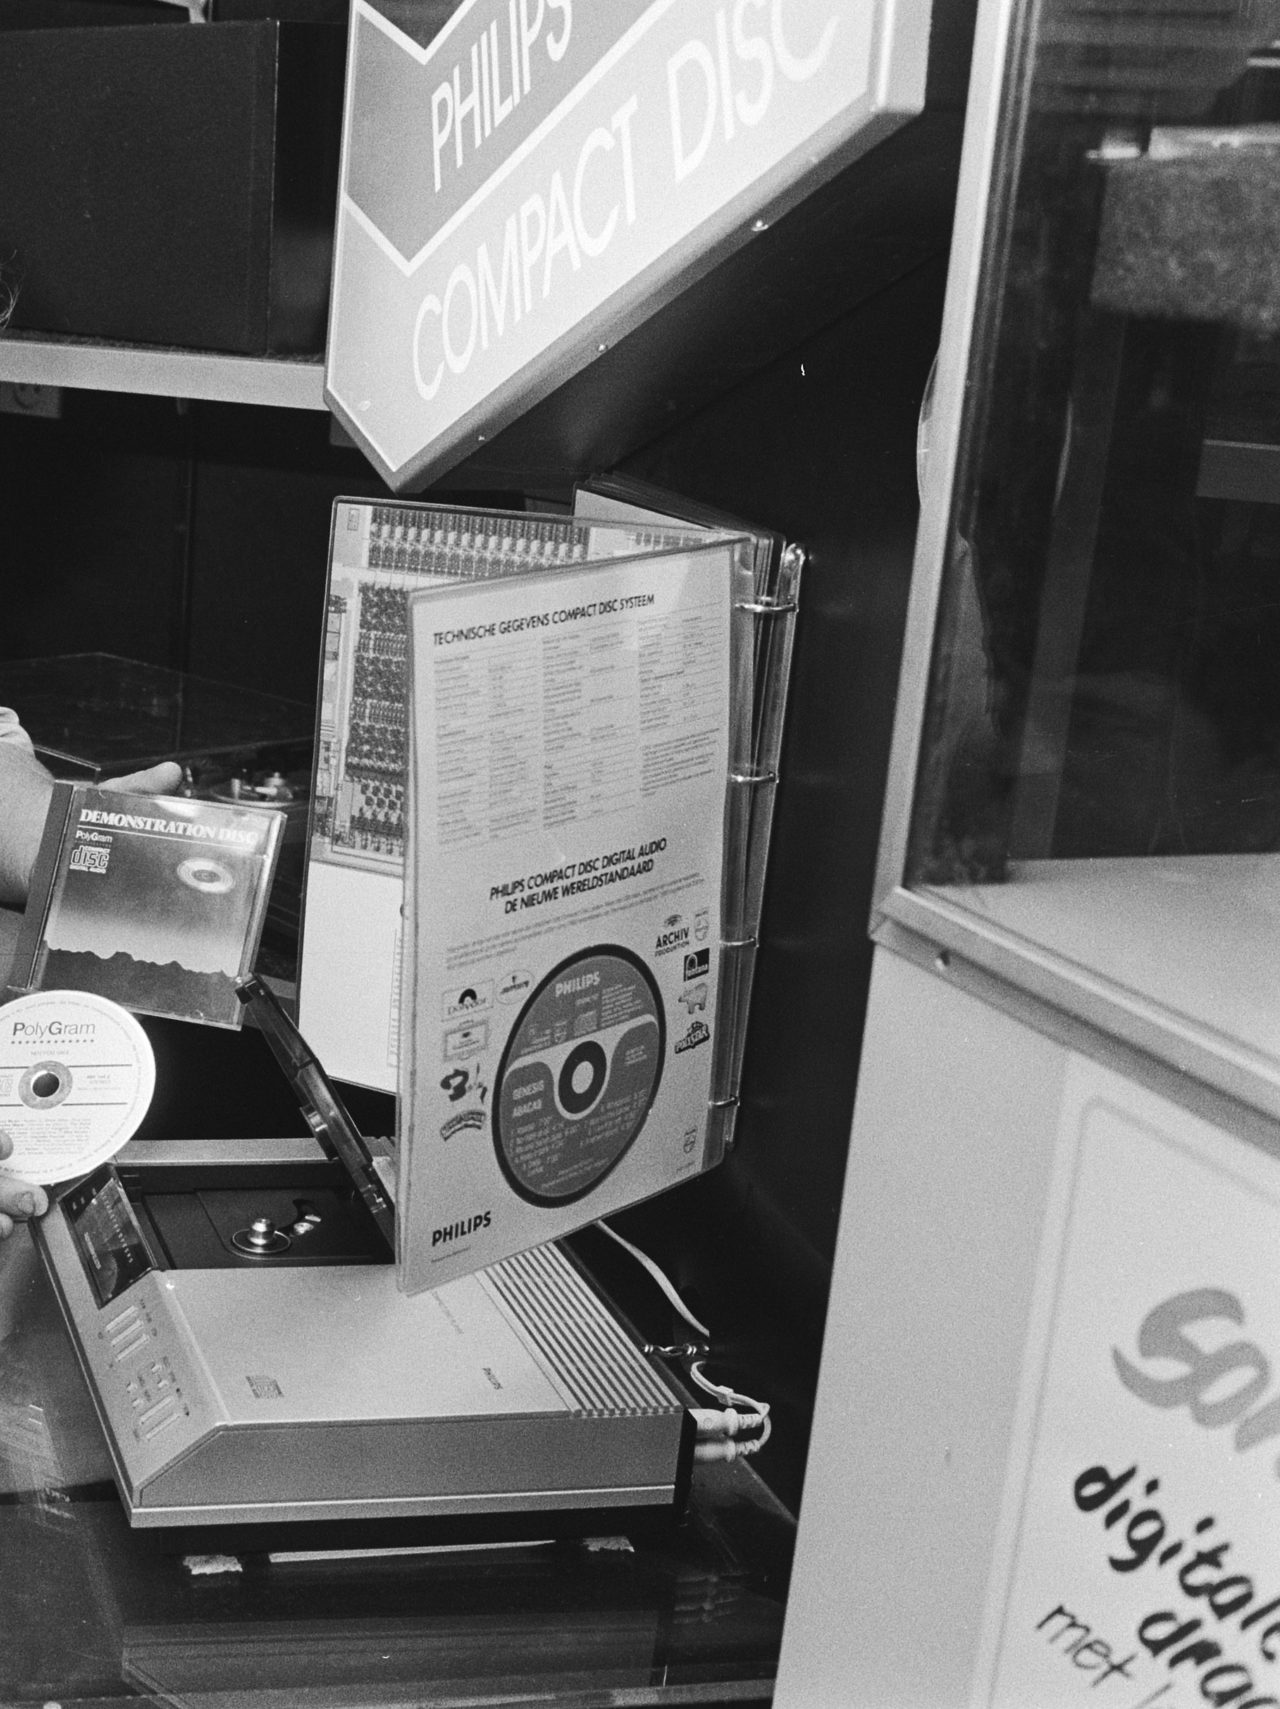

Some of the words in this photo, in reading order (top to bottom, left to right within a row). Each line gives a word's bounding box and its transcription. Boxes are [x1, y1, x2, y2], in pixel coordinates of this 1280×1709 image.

[431, 0, 572, 193] PHILIPS
[413, 93, 638, 400] COMPACT
[666, 0, 840, 184] DISC
[433, 623, 496, 646] TECHNISCHE
[499, 612, 550, 635] GEGEVENS
[552, 603, 597, 624] COMPACT
[599, 598, 618, 615] DISC
[619, 594, 655, 611] SYSTEEM
[75, 830, 113, 844] PolyGram
[79, 808, 216, 839] DEMONSTRATION
[70, 845, 109, 868] disc
[489, 879, 525, 900] PHILIPS
[527, 864, 576, 890] COMPACT
[578, 857, 600, 876] DISC
[601, 848, 636, 870] DIGITAL
[637, 837, 667, 858] AUDIO
[505, 898, 517, 914] DE
[520, 886, 559, 909] NIEUWE
[561, 858, 655, 897] WERELDSTANDAARD
[655, 927, 689, 949] ARCHIV
[555, 971, 600, 998] PHILIPS
[12, 1021, 96, 1039] PolyGram
[432, 1210, 492, 1248] PHILIPS
[1037, 1605, 1138, 1687] met
